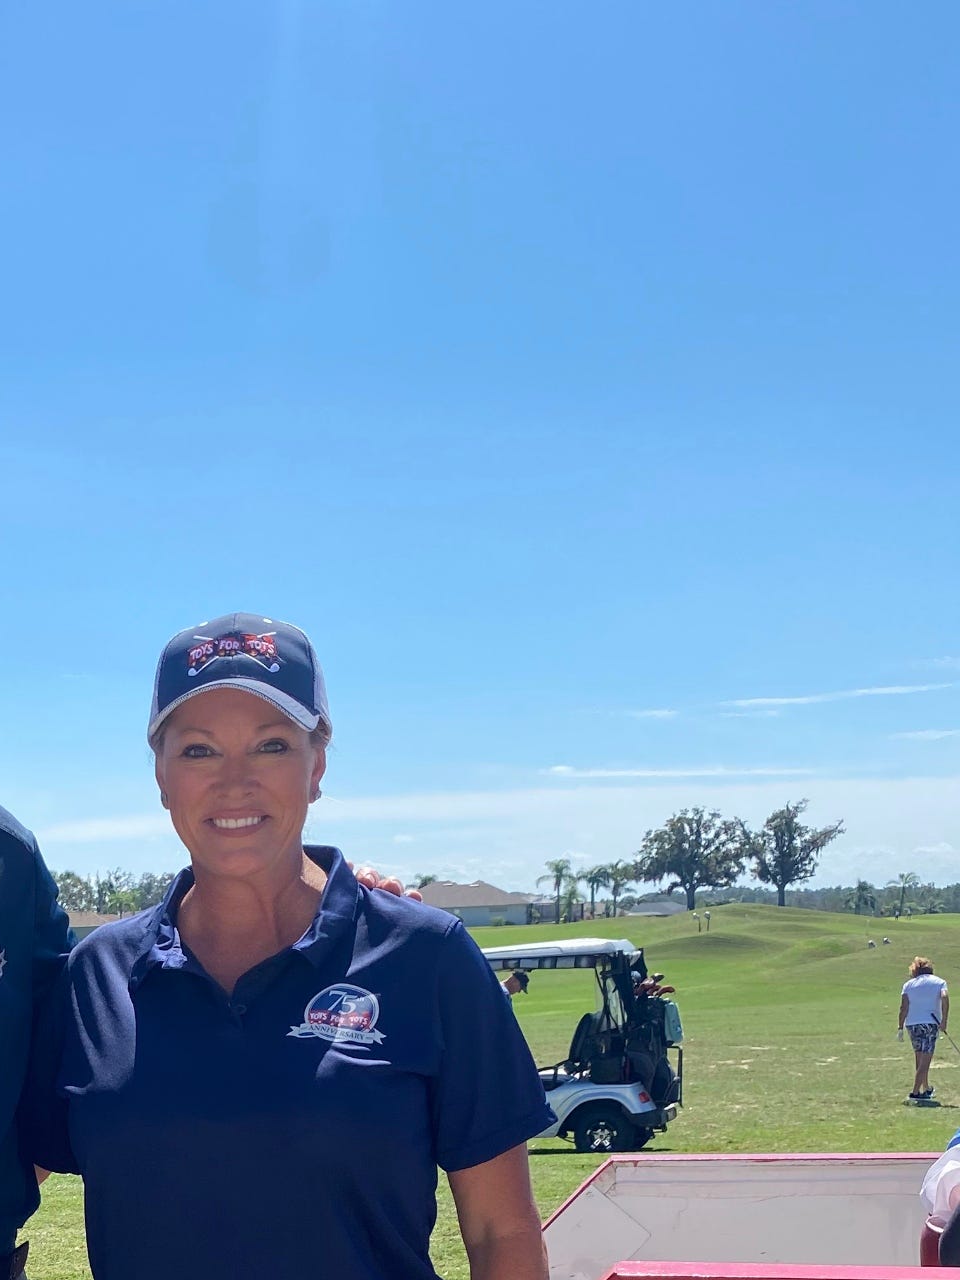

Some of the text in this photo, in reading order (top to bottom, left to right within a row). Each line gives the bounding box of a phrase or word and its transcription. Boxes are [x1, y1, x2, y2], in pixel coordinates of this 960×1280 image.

[190, 639, 275, 660] TOYS FOR TOTS
[328, 990, 358, 1015] 75
